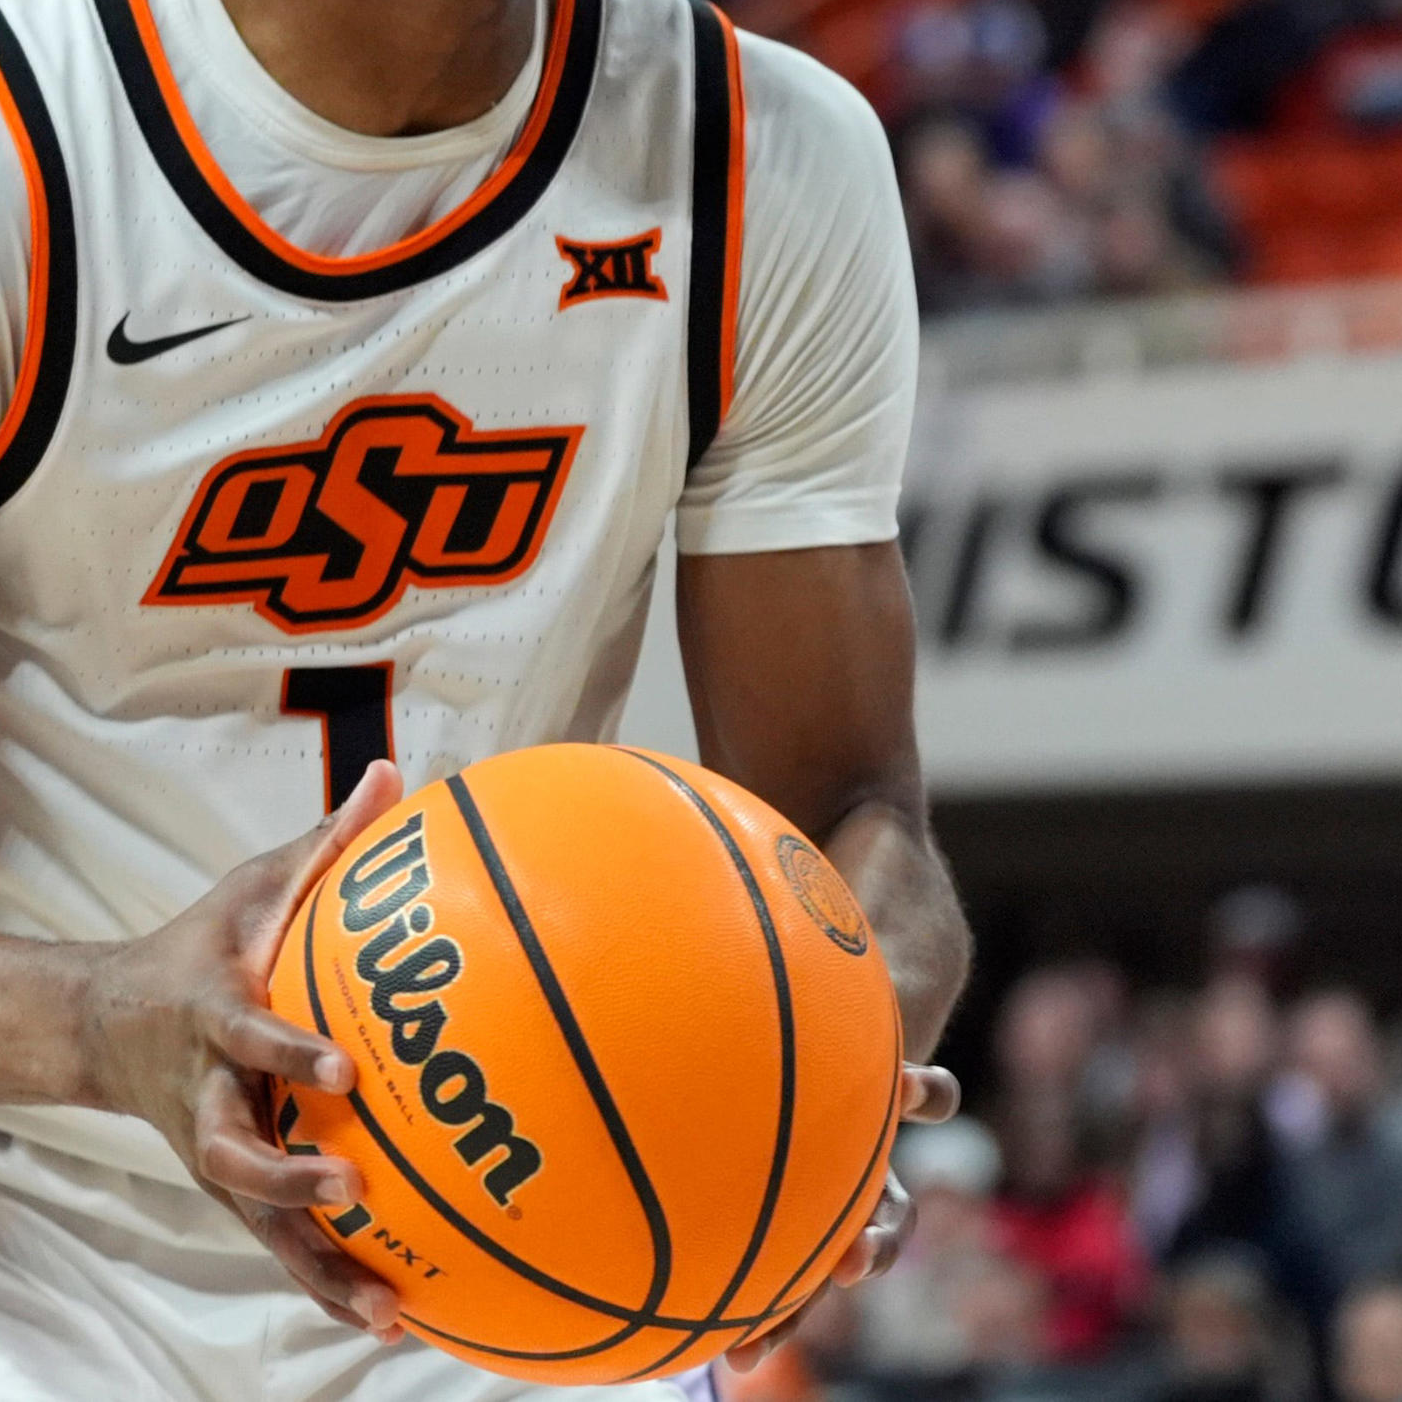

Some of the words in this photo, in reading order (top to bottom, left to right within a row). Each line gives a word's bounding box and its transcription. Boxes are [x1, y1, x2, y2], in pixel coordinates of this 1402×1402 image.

[560, 231, 664, 300] XII
[151, 398, 578, 628] OSU
[280, 661, 394, 815] 1
[336, 808, 544, 1210] Wilson
[357, 1023, 386, 1073] GAME
[386, 1079, 414, 1126] BALL
[372, 1228, 448, 1278] NXT
